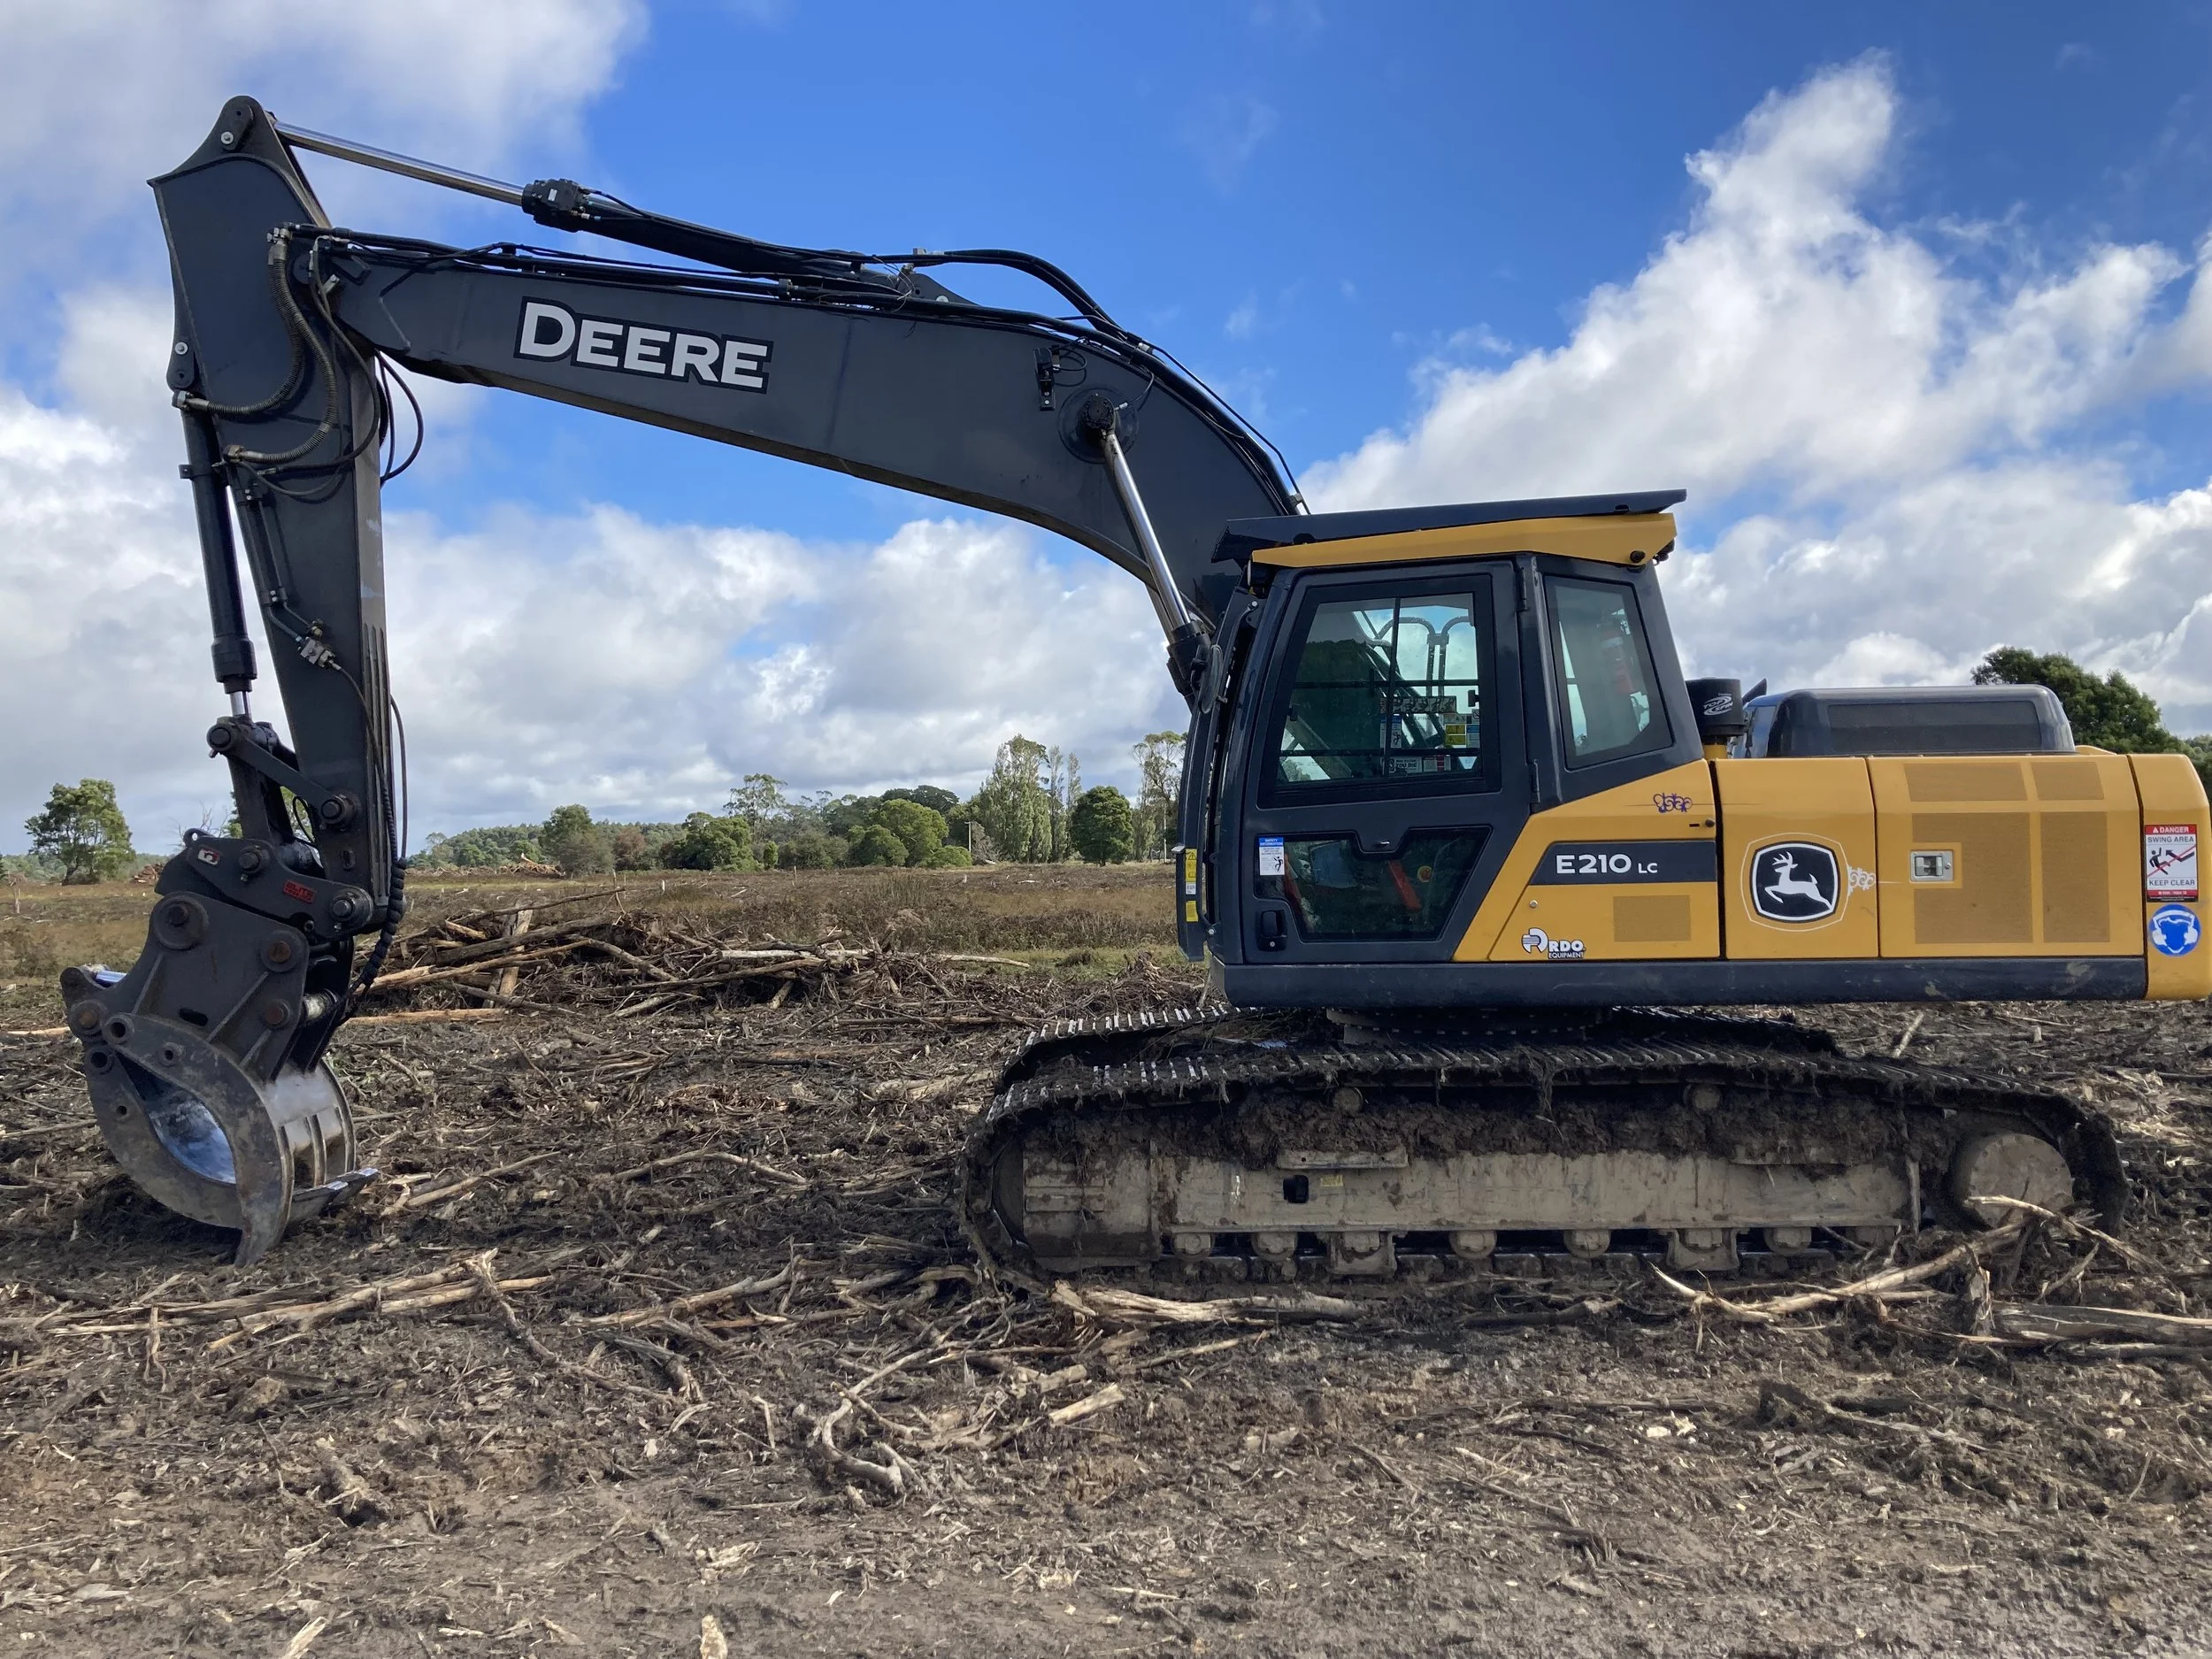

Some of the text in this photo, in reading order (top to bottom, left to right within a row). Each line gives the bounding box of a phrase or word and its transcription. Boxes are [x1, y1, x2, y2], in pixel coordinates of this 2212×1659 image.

[519, 301, 769, 389] DEERE
[1556, 854, 1658, 874] E210 LC
[1548, 940, 1584, 952] RDO
